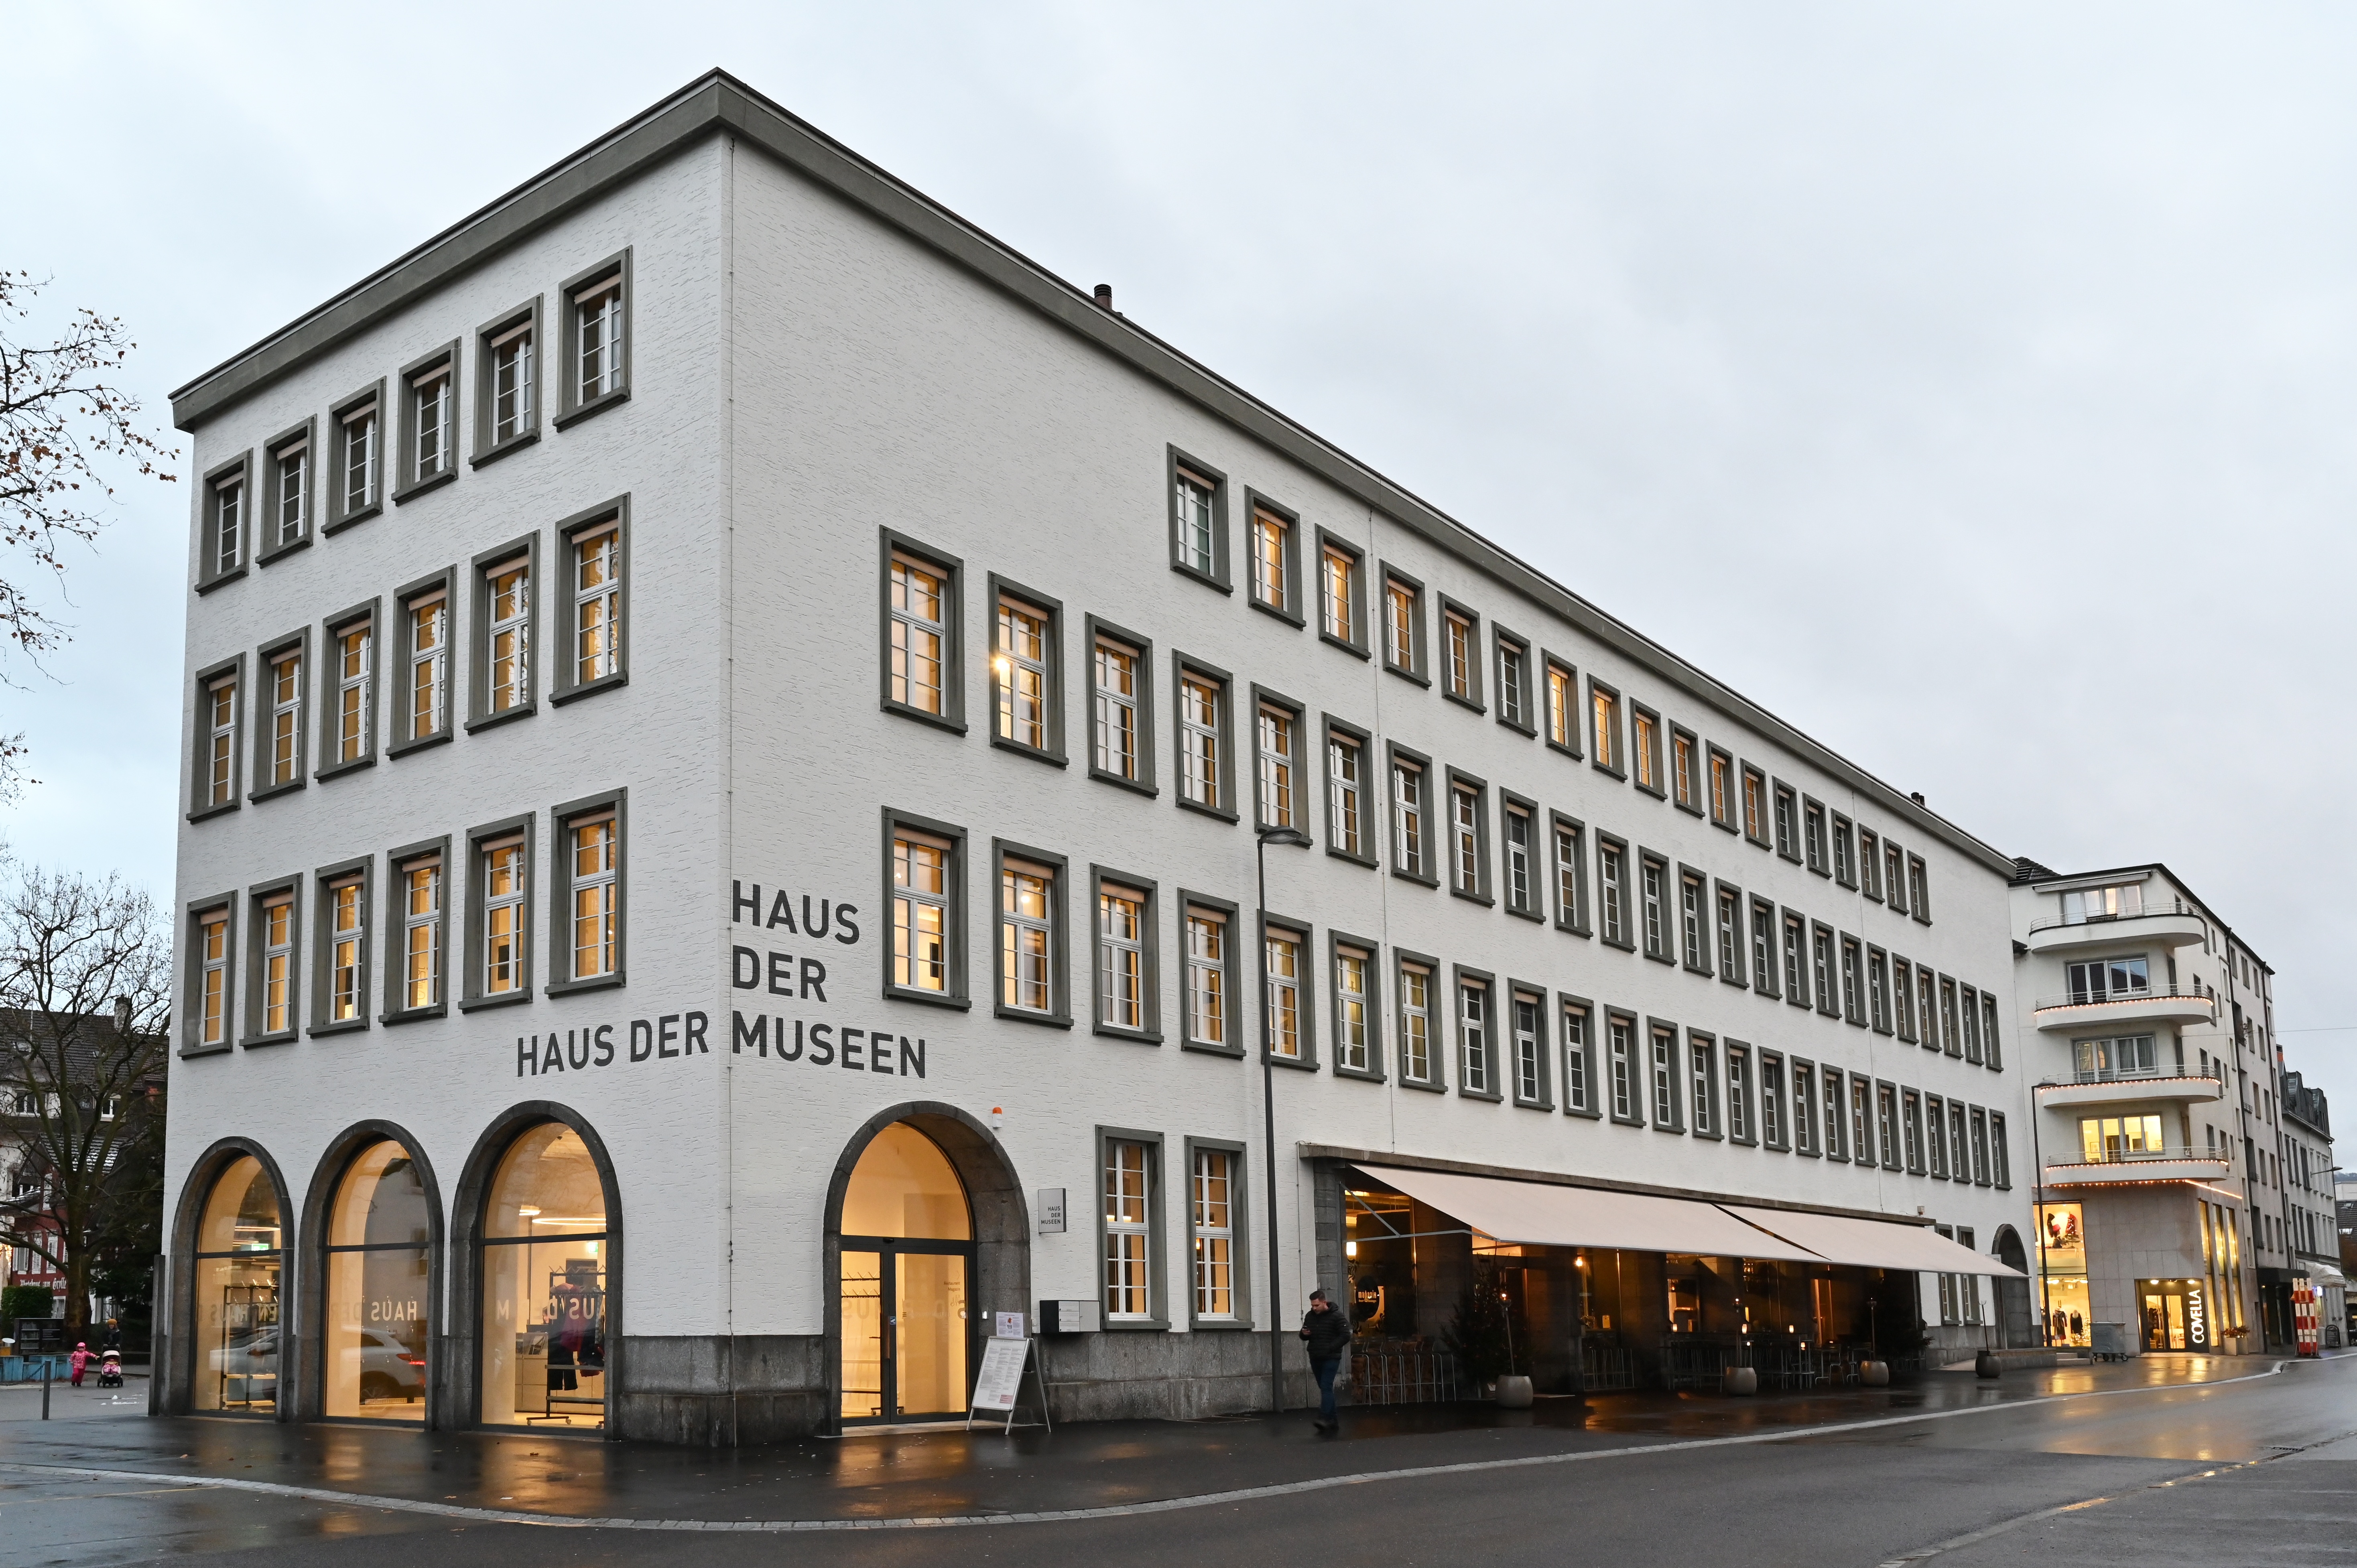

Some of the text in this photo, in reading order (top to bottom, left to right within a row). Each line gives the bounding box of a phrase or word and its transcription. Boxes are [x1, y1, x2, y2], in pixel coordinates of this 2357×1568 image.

[732, 879, 859, 945] HAUS
[732, 945, 827, 1003] DER
[517, 1010, 926, 1079] HAUS DER MUSEEN
[2188, 1289, 2205, 1344] COVELLA
